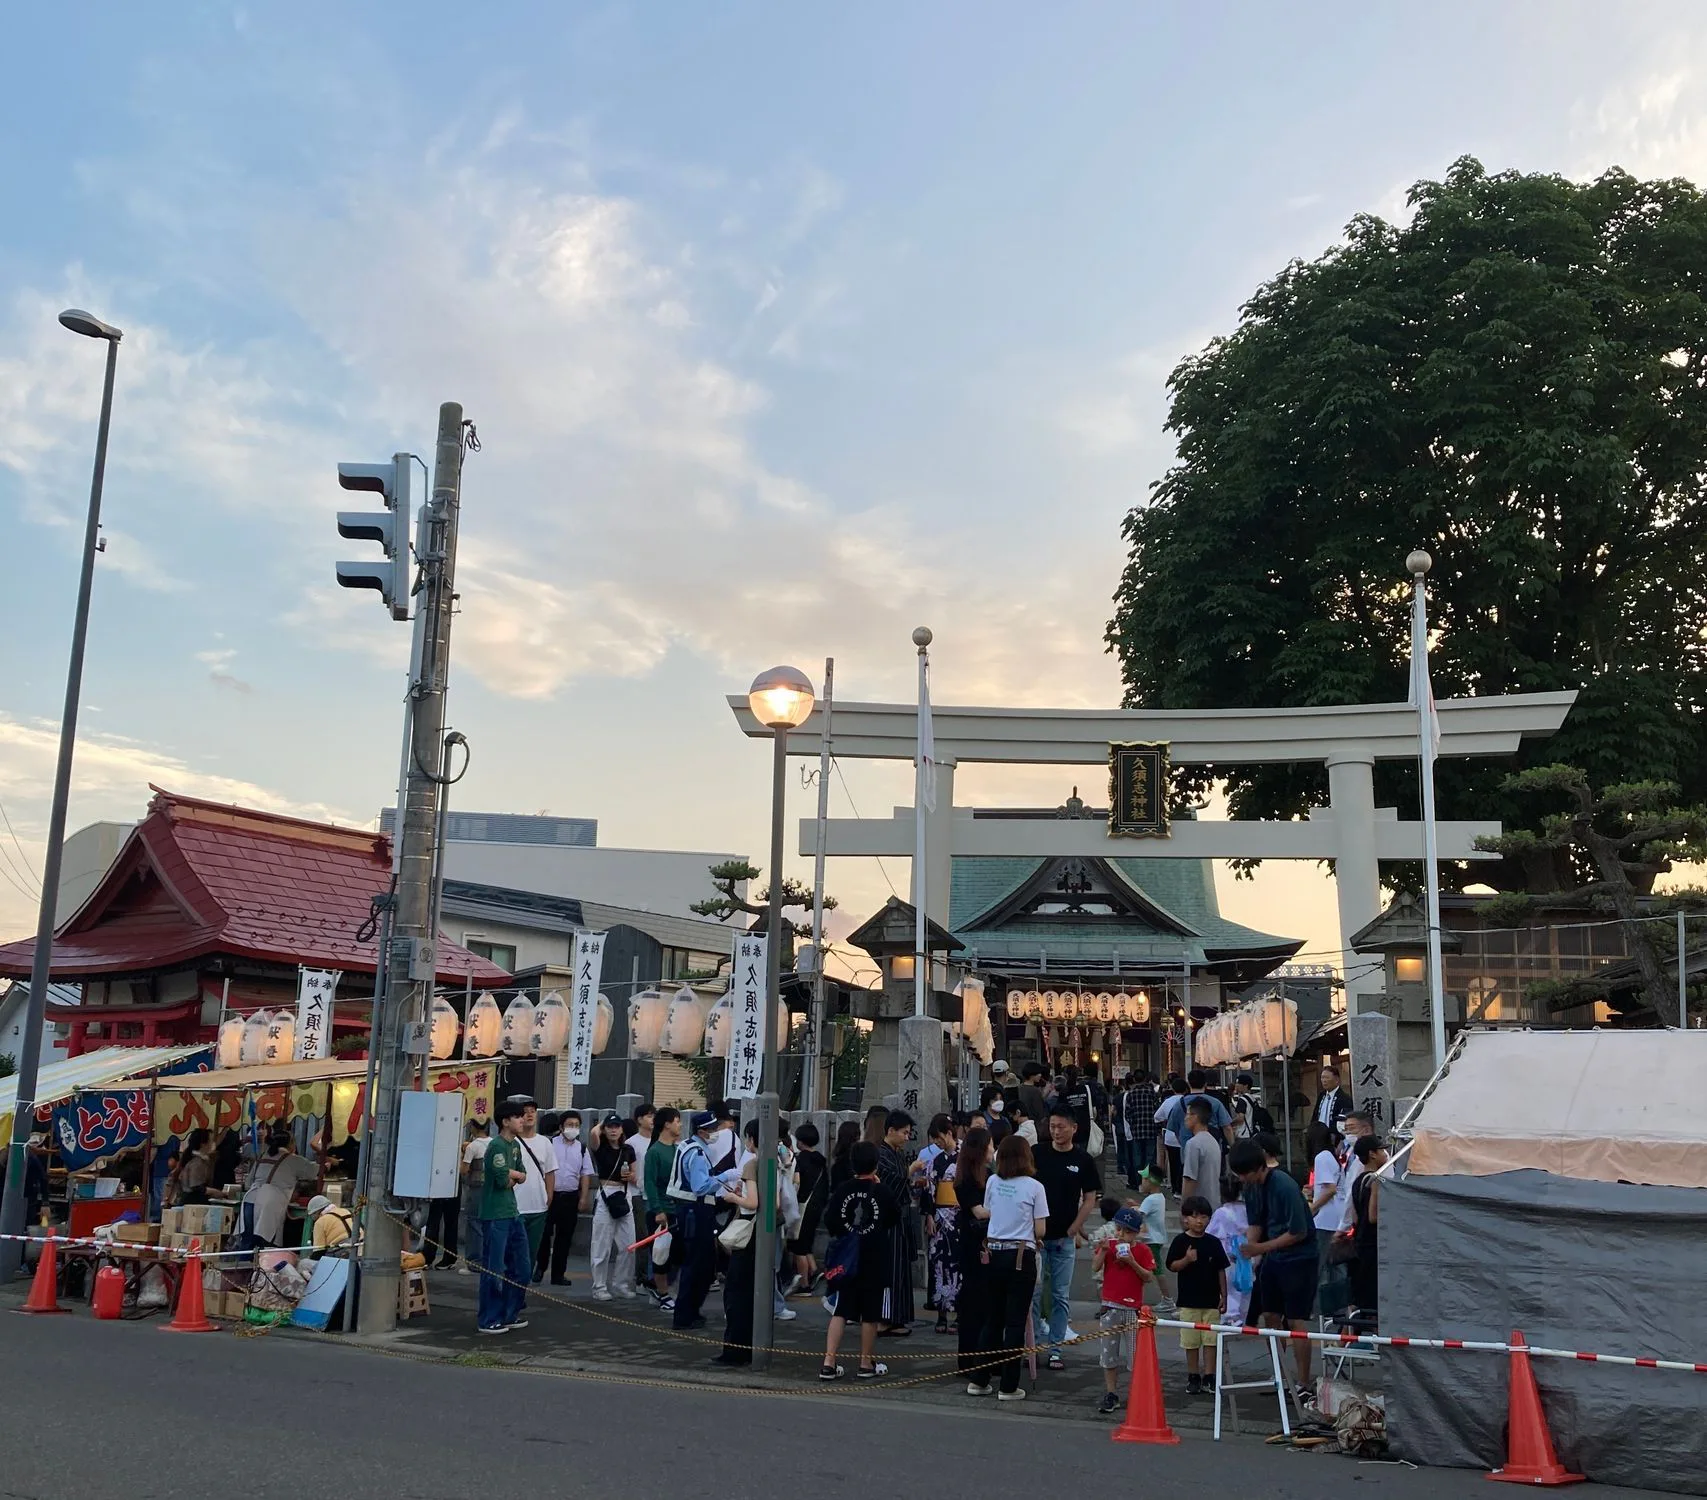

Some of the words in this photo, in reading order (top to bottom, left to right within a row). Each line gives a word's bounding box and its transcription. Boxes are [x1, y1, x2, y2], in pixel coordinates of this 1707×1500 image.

[1131, 756, 1149, 820] 久須志神社
[580, 940, 600, 954] 奉納
[572, 958, 593, 1077] 久須志神社
[474, 1071, 488, 1115] 特製
[1360, 1063, 1385, 1139] 久須
[841, 1193, 856, 1219] POCKET
[857, 1192, 879, 1220] MOSTERS
